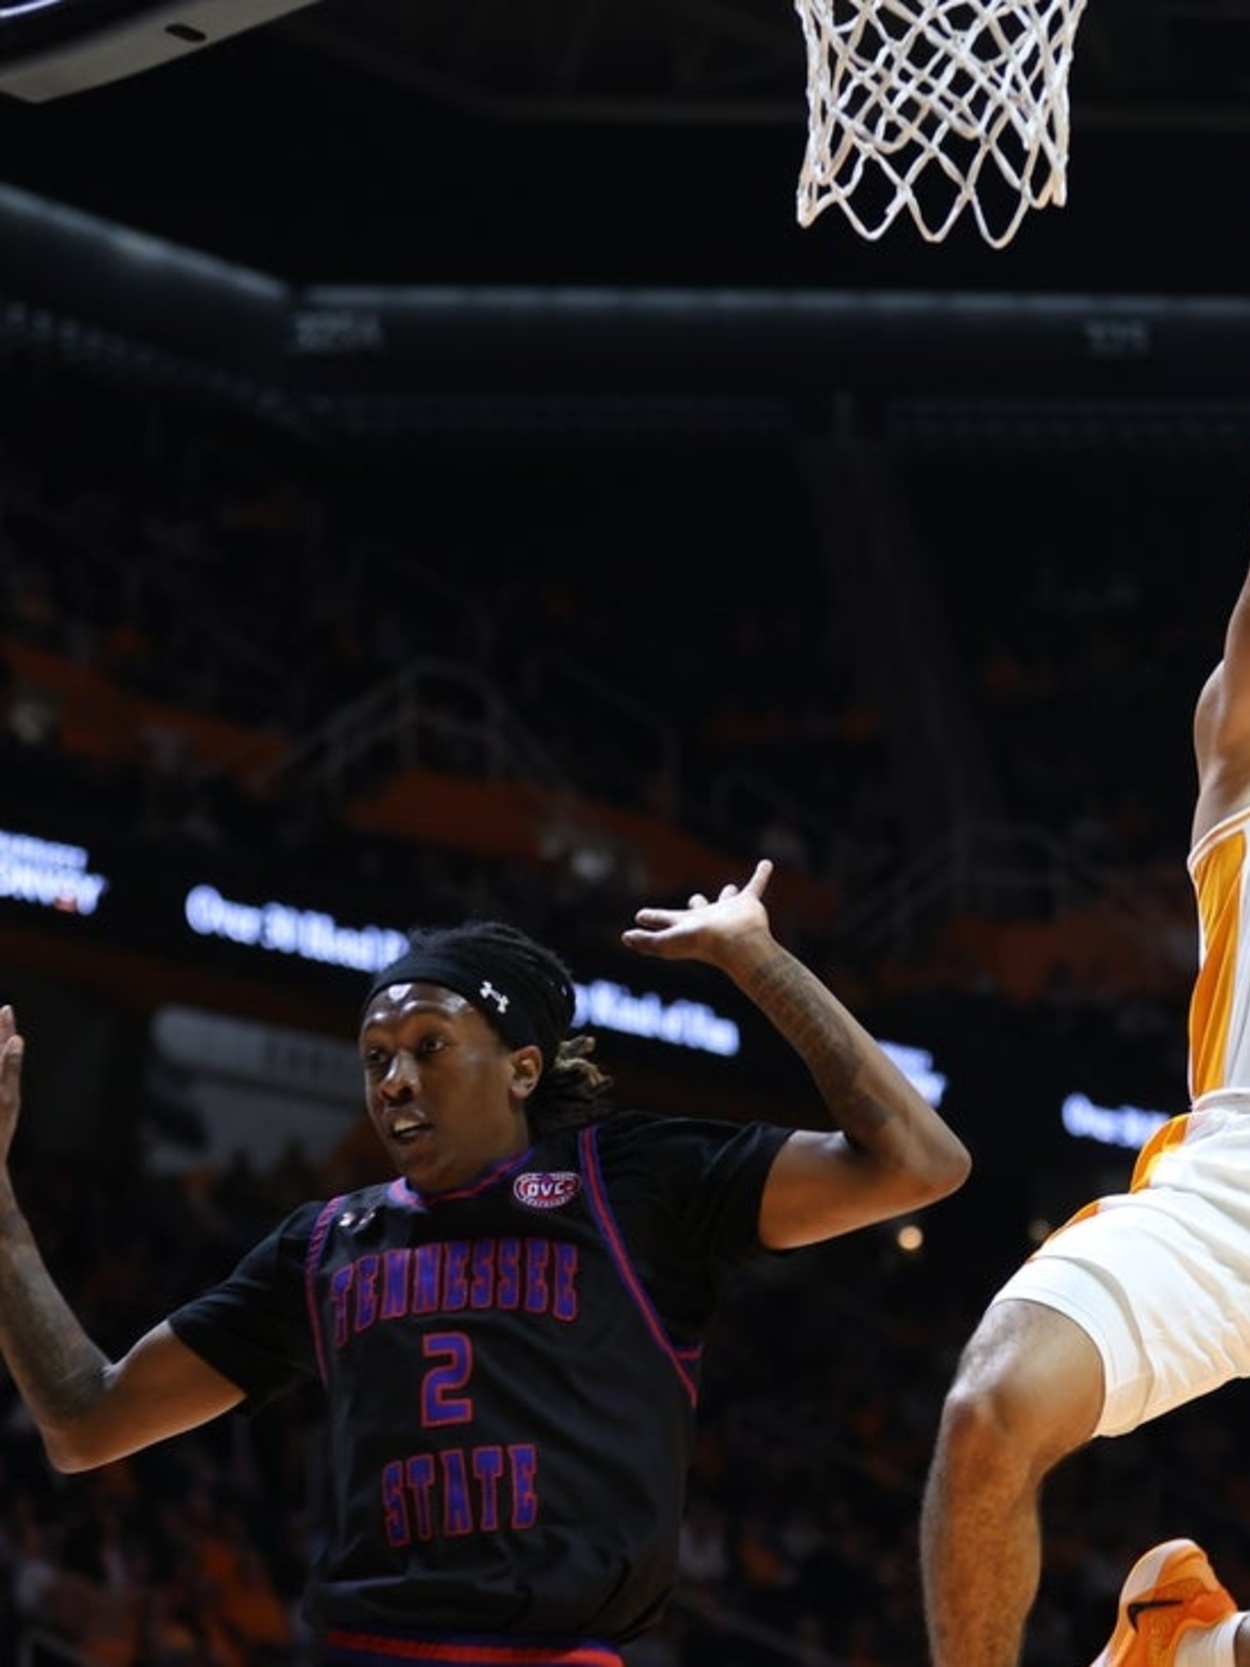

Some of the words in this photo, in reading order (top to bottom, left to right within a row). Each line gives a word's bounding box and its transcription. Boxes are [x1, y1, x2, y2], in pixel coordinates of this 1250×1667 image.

[526, 1181, 565, 1197] OVC
[329, 1237, 579, 1348] TENNESSEE
[420, 1330, 474, 1429] 2
[380, 1442, 539, 1548] STATE
